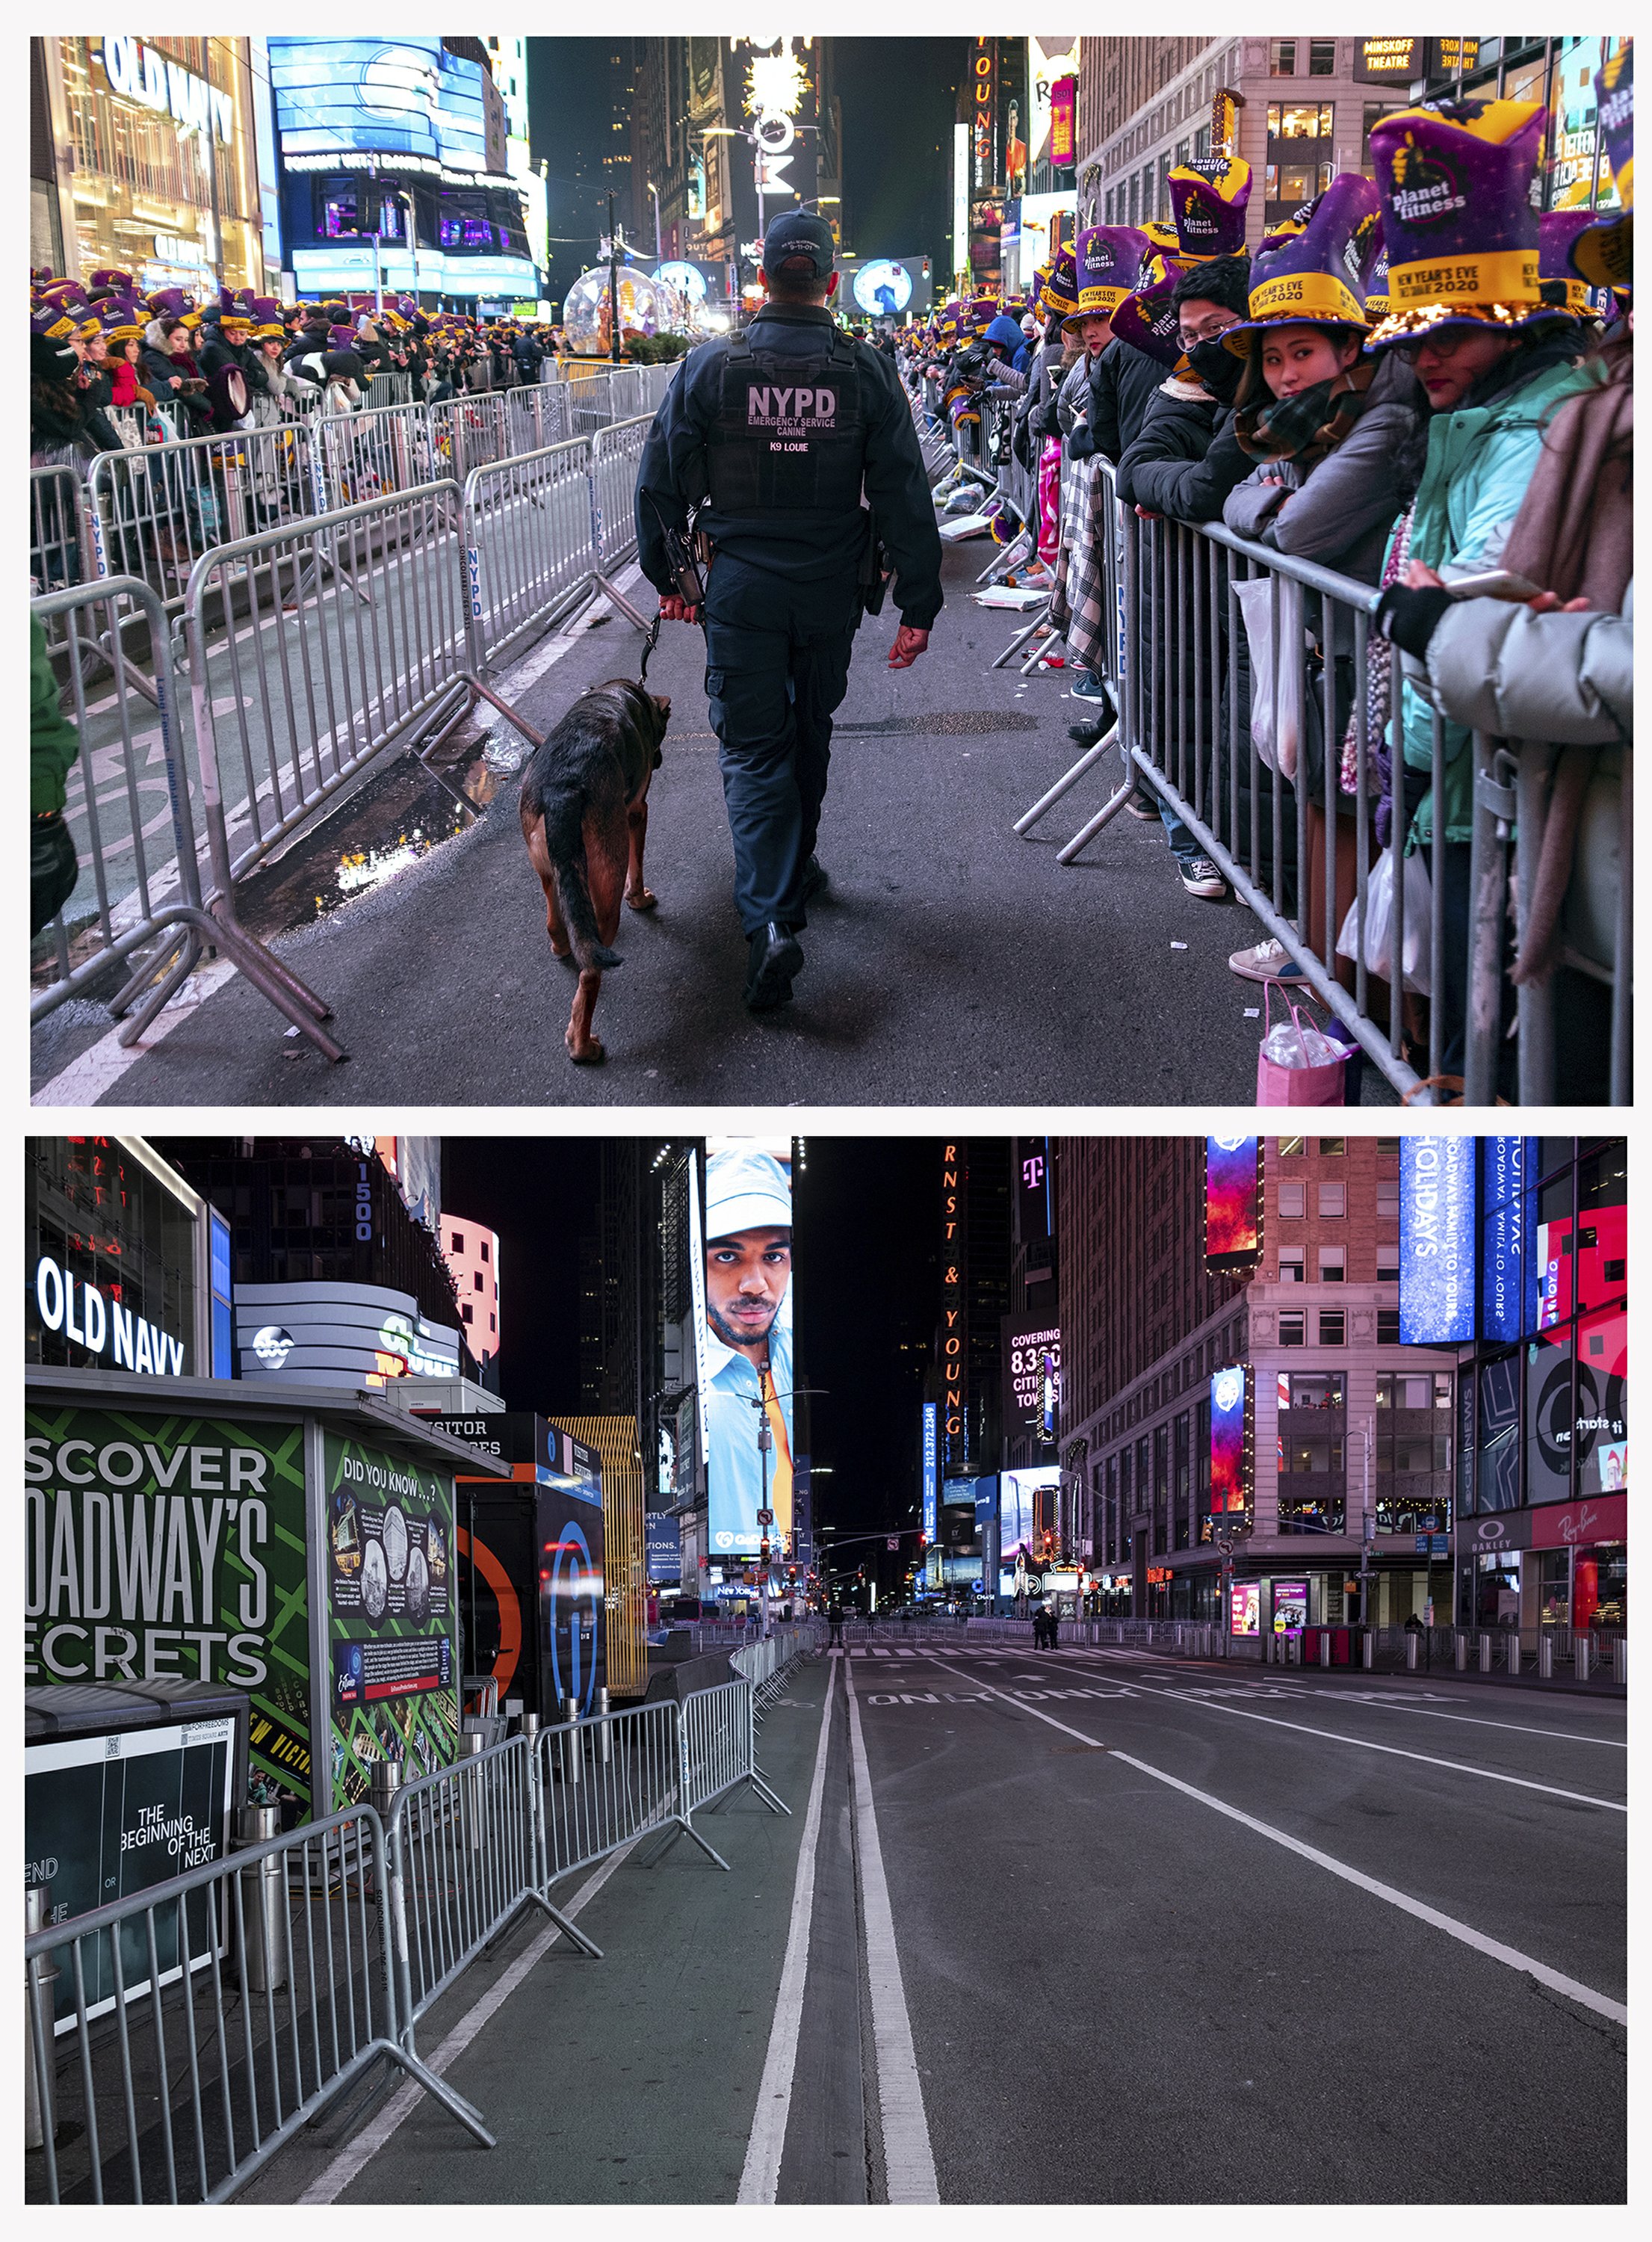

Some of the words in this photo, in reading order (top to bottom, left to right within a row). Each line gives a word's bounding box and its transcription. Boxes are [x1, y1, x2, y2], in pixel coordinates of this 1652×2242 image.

[1364, 39, 1414, 55] MINSKOFF
[105, 36, 169, 112] OLD
[1367, 55, 1410, 70] THEATRE
[1392, 180, 1450, 211] planet
[1400, 193, 1467, 220] fitness
[1183, 217, 1212, 227] planet
[1187, 225, 1219, 234] fitness
[1085, 255, 1109, 266] planet
[1087, 262, 1115, 270] fitness
[1414, 268, 1453, 282] YEAR'S
[1456, 265, 1479, 279] EVE
[1271, 291, 1303, 303] 2020
[1287, 280, 1303, 291] EVE
[1434, 280, 1479, 293] 2020
[748, 386, 836, 418] NYPD
[748, 416, 799, 427] EMERGENCY
[800, 417, 835, 428] SERVICE
[776, 427, 806, 436] CANINE
[770, 442, 782, 451] K9
[784, 442, 808, 452] LOUIE
[315, 463, 327, 508] NYPD
[90, 514, 106, 575] NYPD
[468, 549, 482, 617] NYPD
[1023, 1155, 1044, 1190] T
[1446, 1136, 1458, 1201] ROADWAY
[356, 1163, 372, 1242] 1500
[944, 1145, 958, 1239] RNST
[1446, 1251, 1458, 1272] TO
[944, 1266, 959, 1284] &
[37, 1256, 106, 1353] OLD
[113, 1300, 185, 1377] NAVY
[1012, 1328, 1061, 1348] COVERING
[945, 1310, 962, 1435] YOUNG
[1463, 1388, 1473, 1446] NEWS
[926, 1407, 935, 1468] 212.372.2349
[25, 1437, 267, 1492] SCOVER
[344, 1457, 365, 1482] DID
[366, 1463, 386, 1489] YOU
[389, 1471, 418, 1498] KNOW
[25, 1487, 267, 1628] OADWAY'S
[1471, 1540, 1512, 1551] OAKLEY
[25, 1622, 267, 1686] ECRETS
[867, 1691, 995, 1706] ONLY
[1012, 1687, 1142, 1701] ONLY
[138, 1803, 164, 1826] THE
[121, 1815, 193, 1852] BEGINNING
[167, 1832, 186, 1856] OF
[185, 1826, 211, 1849] THE
[185, 1842, 217, 1868] NEXT
[105, 1876, 117, 1889] OR
